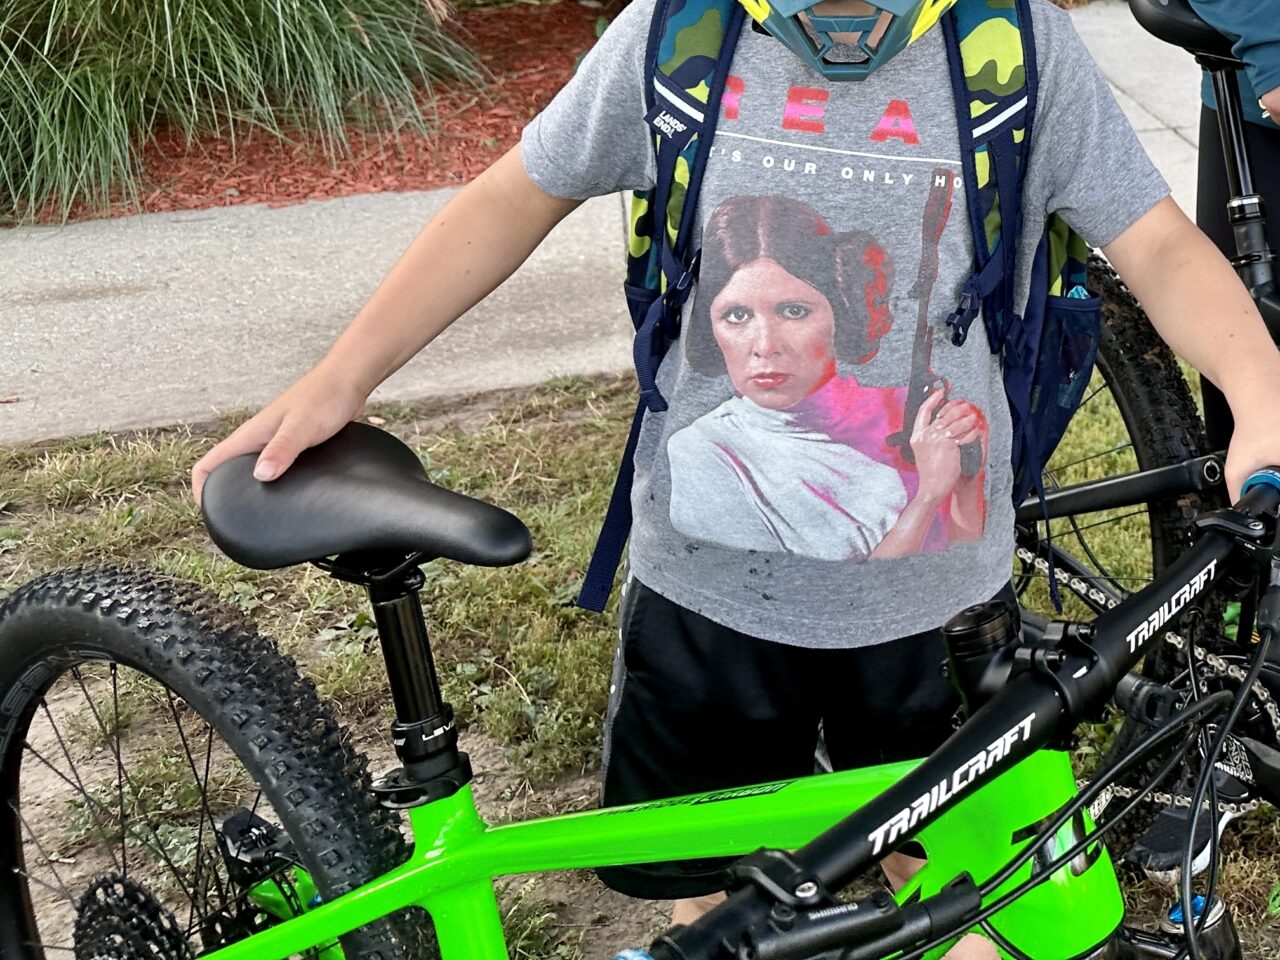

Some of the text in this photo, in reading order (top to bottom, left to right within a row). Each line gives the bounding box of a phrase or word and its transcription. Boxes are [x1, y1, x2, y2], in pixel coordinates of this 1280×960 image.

[762, 156, 817, 175] OUR
[841, 168, 914, 186] ONLY
[1126, 558, 1218, 653] TRAILCRAFT
[868, 712, 1036, 856] TRAILCRAFT
